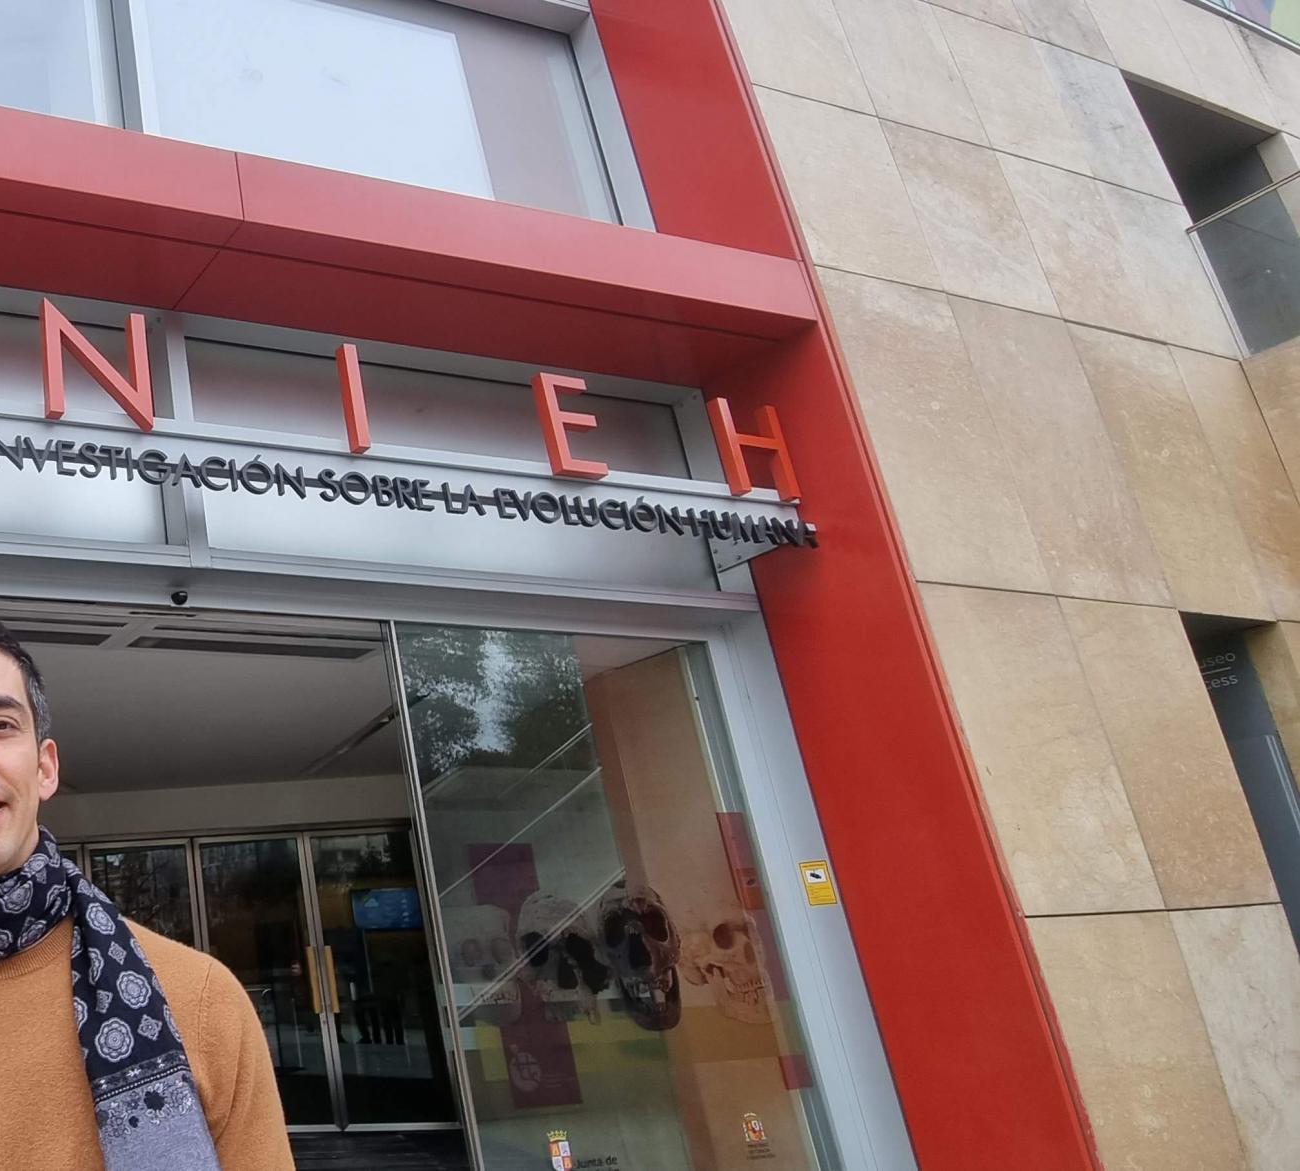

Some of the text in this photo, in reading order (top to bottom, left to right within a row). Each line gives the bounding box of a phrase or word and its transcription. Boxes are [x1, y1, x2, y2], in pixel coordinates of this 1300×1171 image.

[318, 468, 435, 512] SOBRE
[441, 482, 487, 516] LA
[493, 487, 684, 536] EVOLUCIÓN
[685, 508, 820, 549] HUMANA
